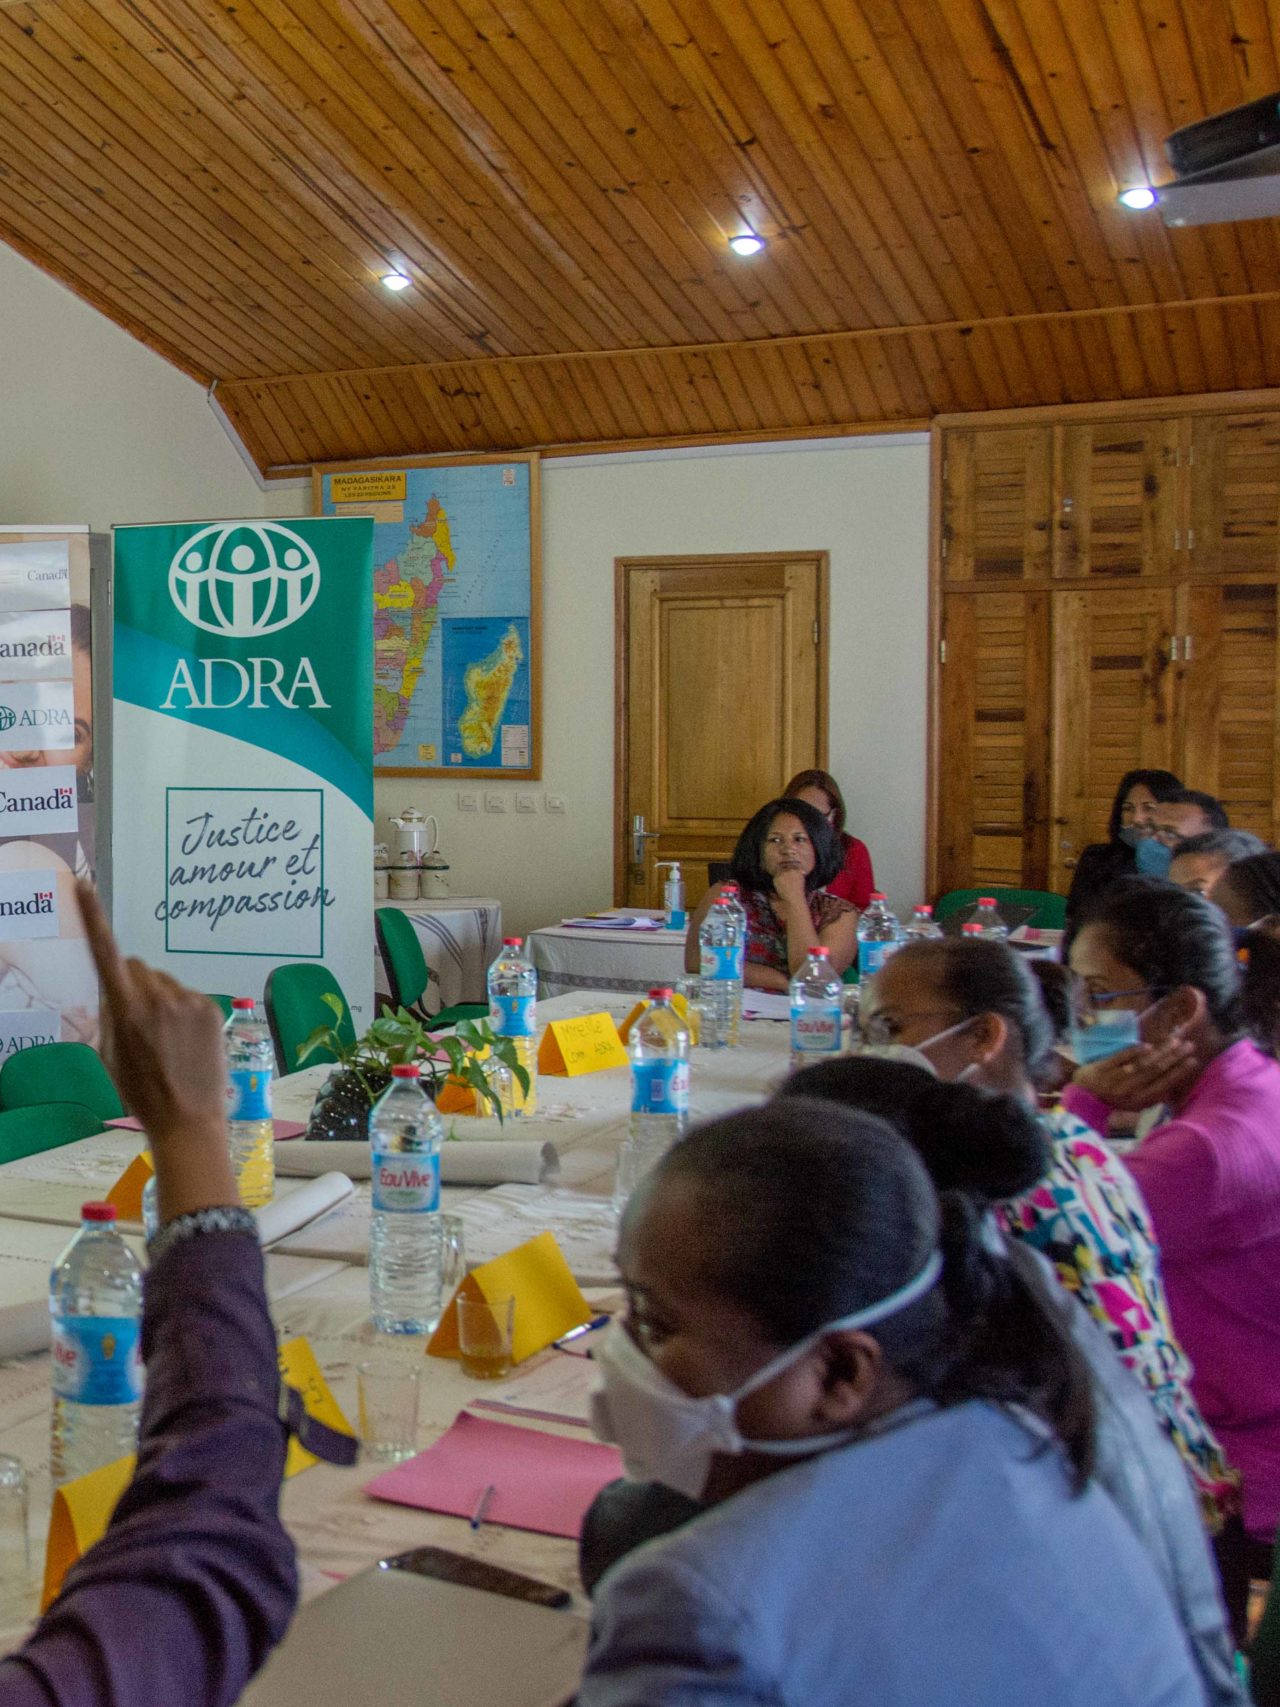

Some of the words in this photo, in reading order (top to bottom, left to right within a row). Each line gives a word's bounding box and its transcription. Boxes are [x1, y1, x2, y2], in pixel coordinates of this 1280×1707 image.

[333, 475, 402, 487] MADAGASIKARA
[27, 568, 68, 582] Canada
[159, 657, 332, 709] ADRA
[18, 708, 72, 727] ADRA
[181, 807, 302, 855] Justice
[169, 854, 277, 886] amour
[286, 833, 320, 876] et
[154, 879, 336, 932] compassion
